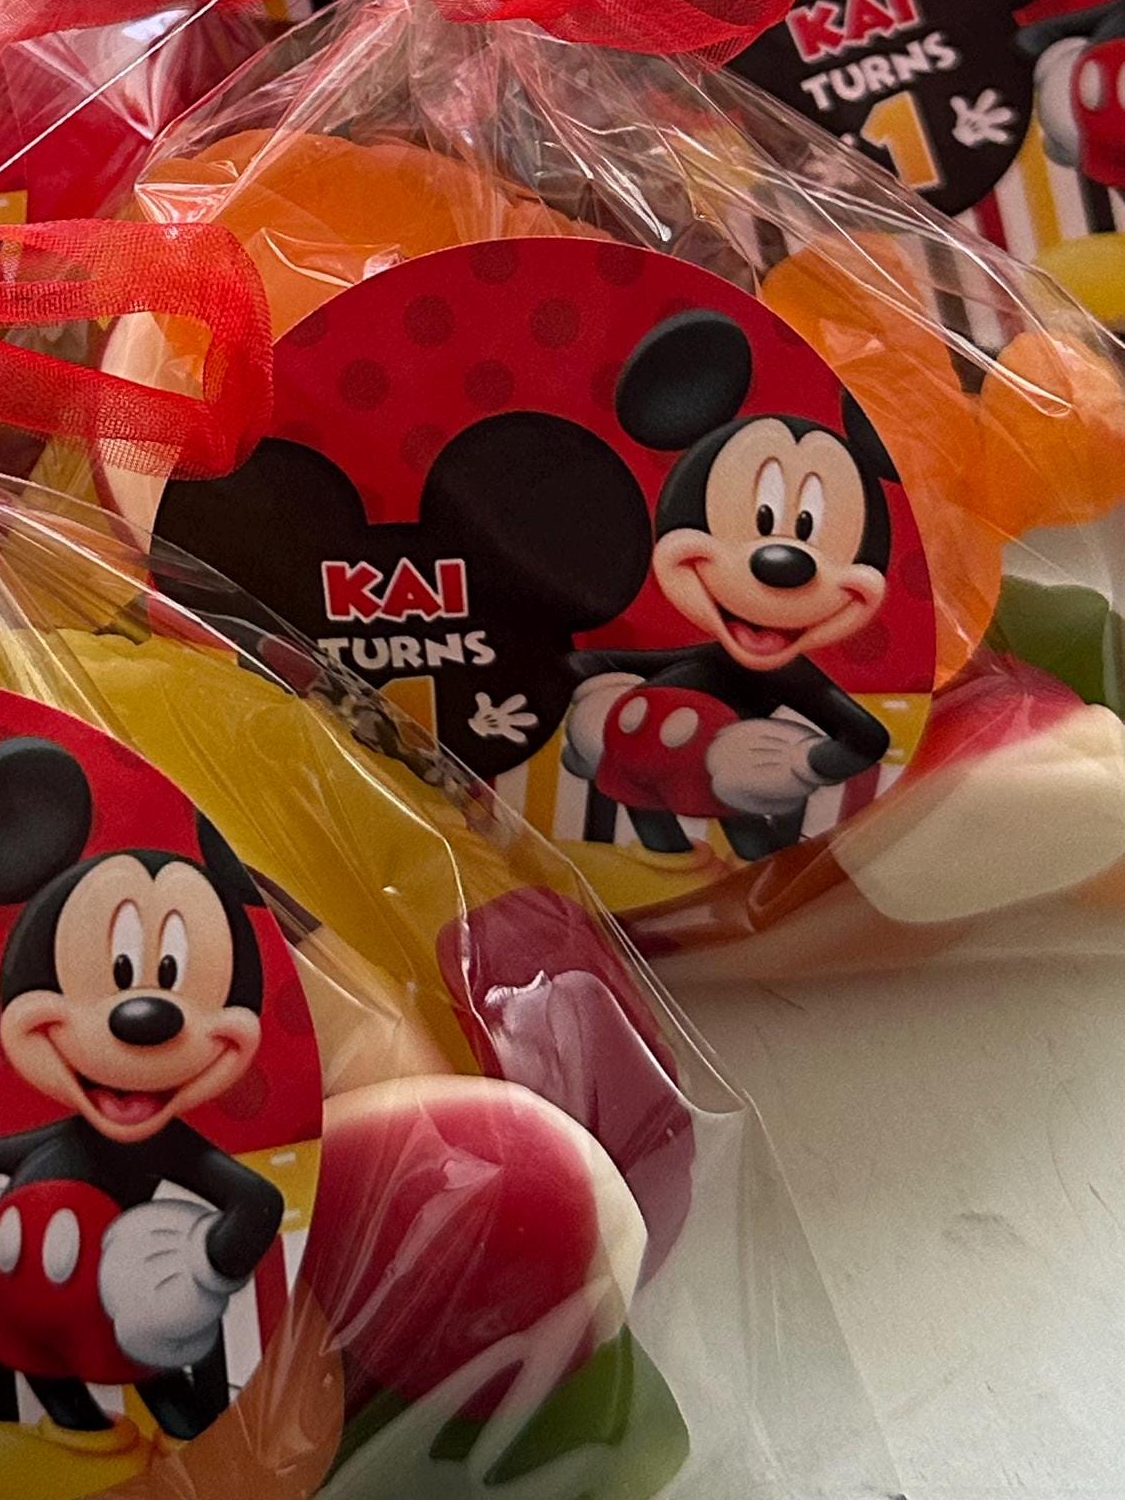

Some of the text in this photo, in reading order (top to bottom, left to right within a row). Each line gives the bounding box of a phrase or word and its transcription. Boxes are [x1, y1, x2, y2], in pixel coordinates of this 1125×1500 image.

[800, 31, 957, 112] TURNS
[860, 90, 941, 189] 1
[321, 556, 470, 624] KAI
[316, 630, 497, 671] TURNS
